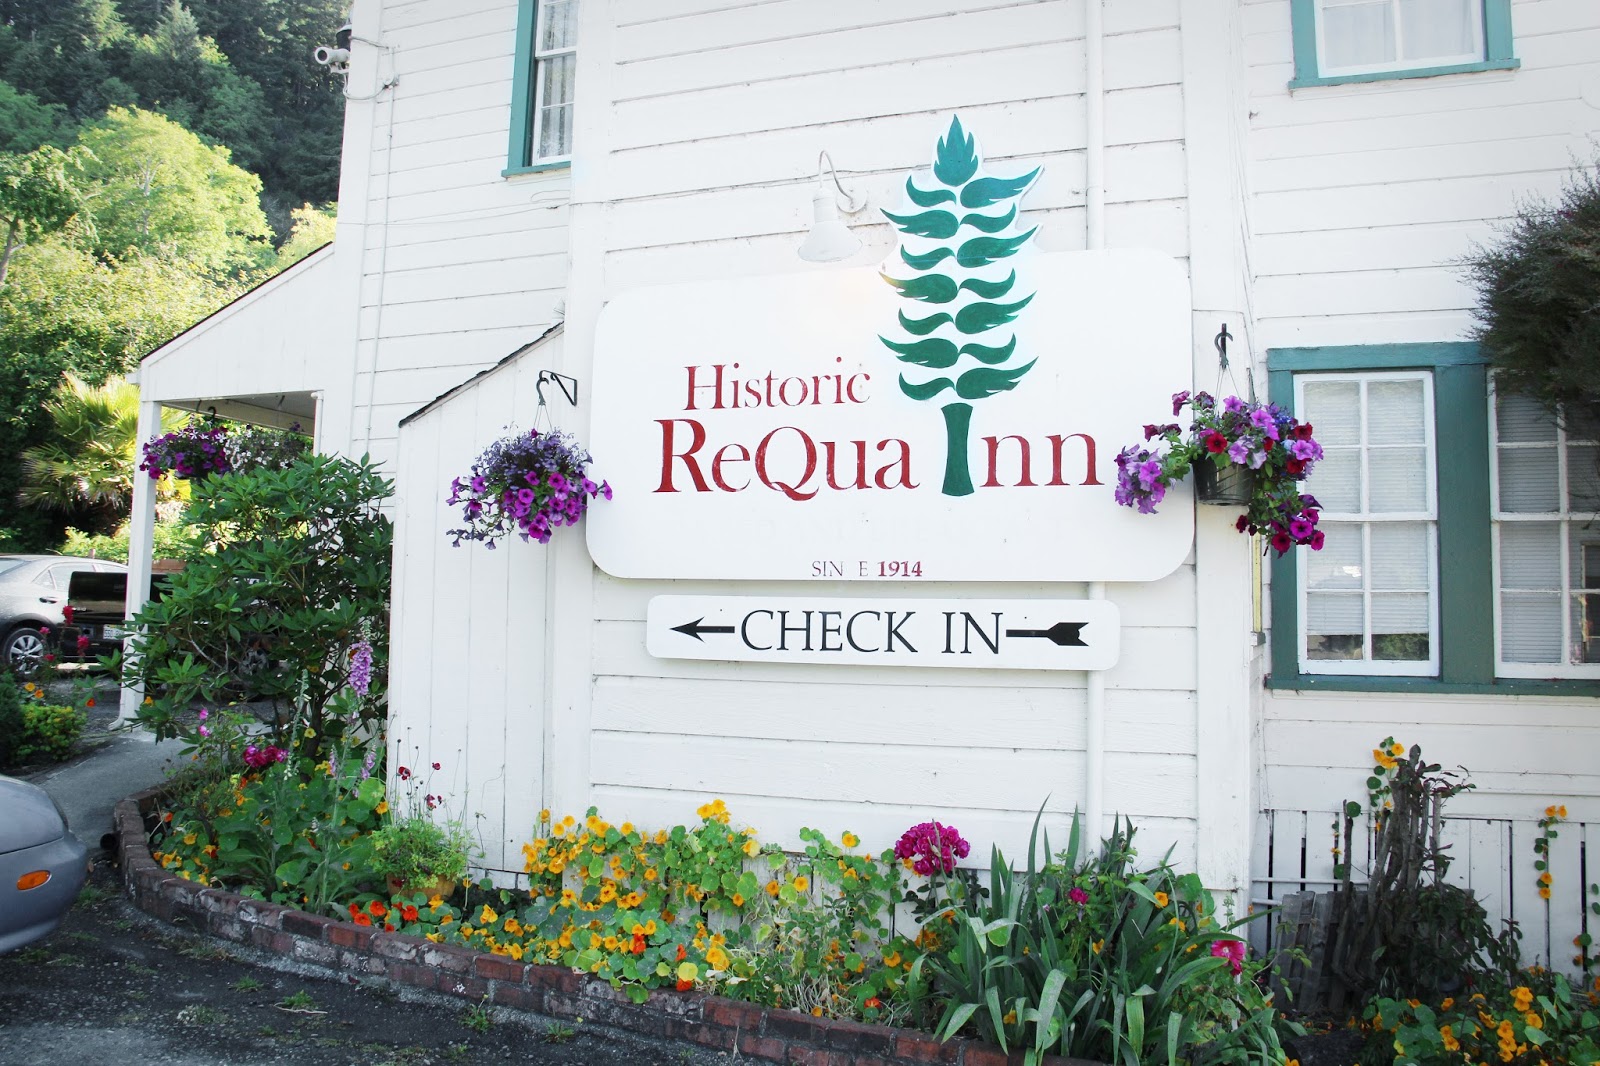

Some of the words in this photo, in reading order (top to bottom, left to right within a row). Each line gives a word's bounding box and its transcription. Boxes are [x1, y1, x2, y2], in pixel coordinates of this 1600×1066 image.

[683, 357, 870, 411] Historic
[651, 418, 921, 502] ReQua
[811, 560, 869, 578] SINE
[877, 560, 923, 578] 1914
[740, 609, 919, 654] CHECK
[940, 611, 1004, 656] IN
